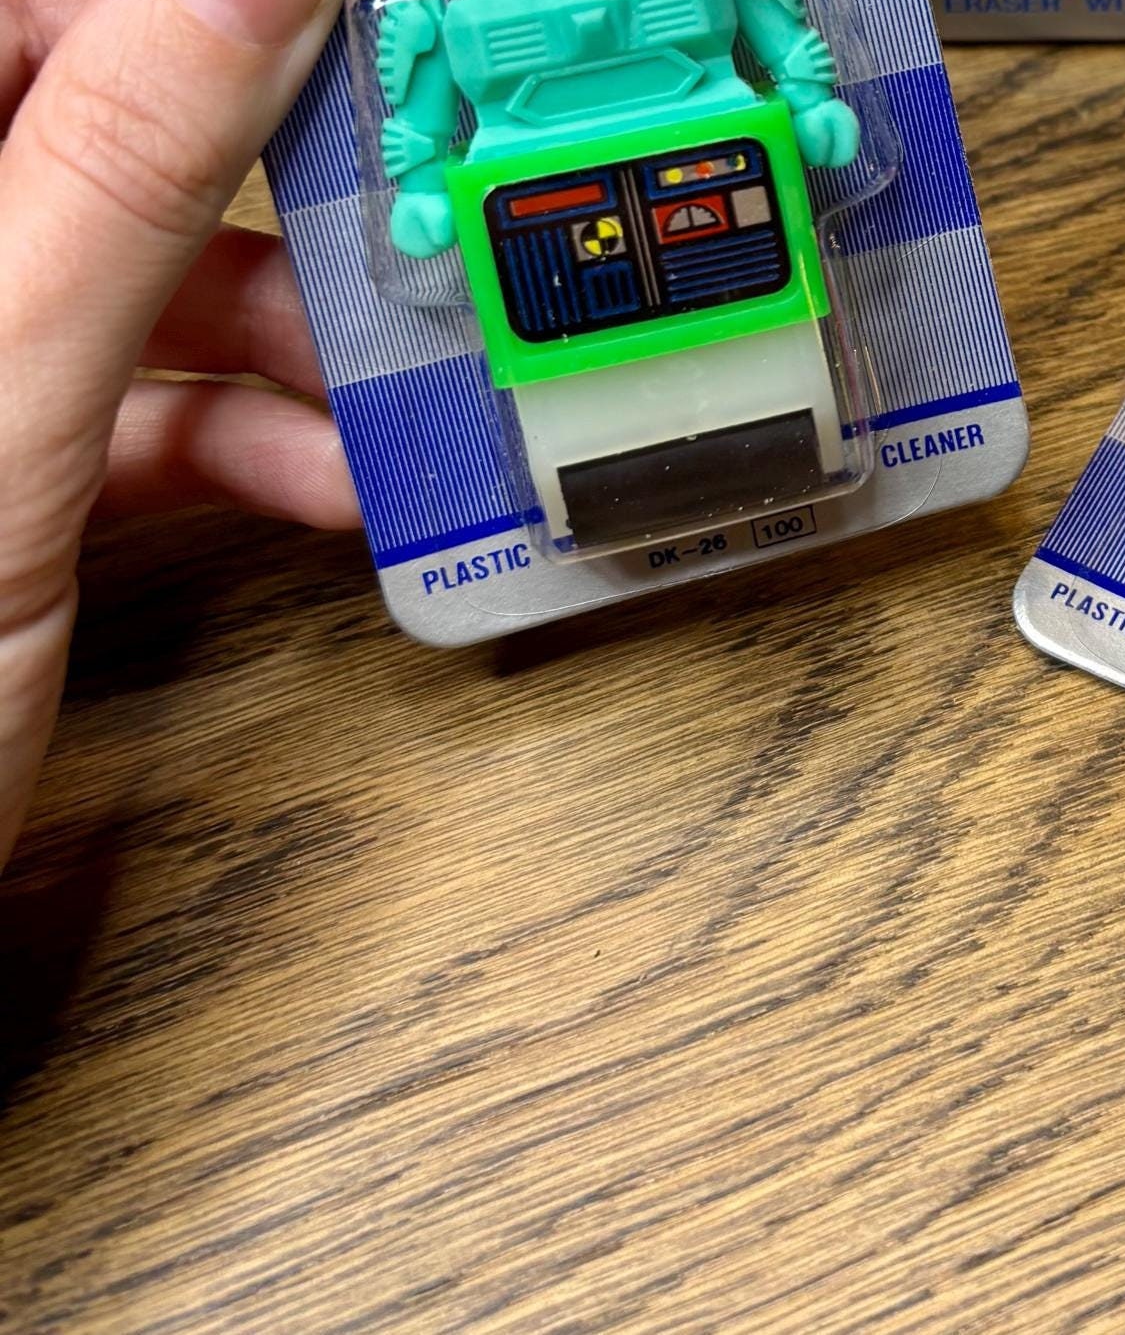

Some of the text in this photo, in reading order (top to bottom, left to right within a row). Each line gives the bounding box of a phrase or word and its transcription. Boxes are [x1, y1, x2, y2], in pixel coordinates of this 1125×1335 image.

[880, 422, 985, 469] CLEANER
[421, 542, 532, 595] PLASTIC
[648, 515, 804, 569] DK-26 100
